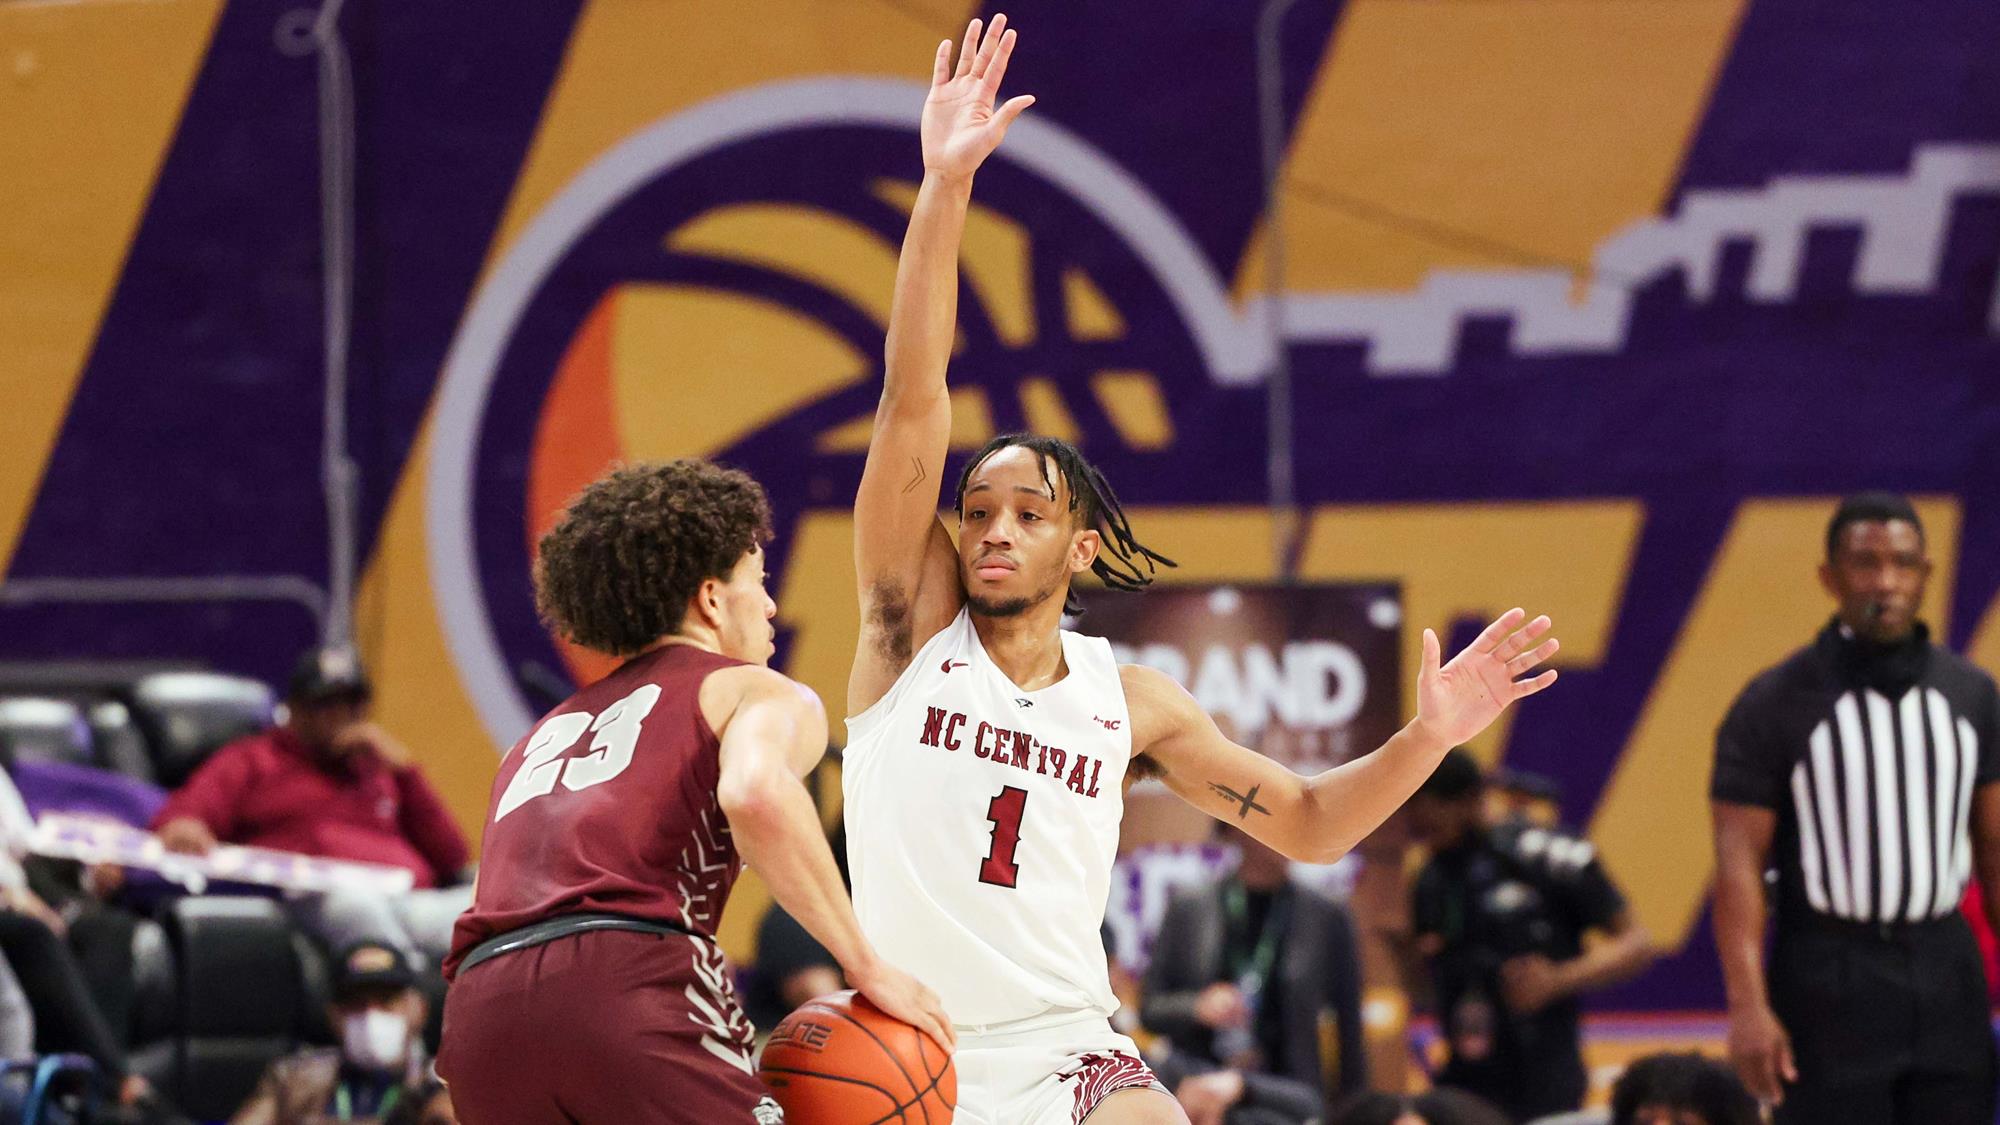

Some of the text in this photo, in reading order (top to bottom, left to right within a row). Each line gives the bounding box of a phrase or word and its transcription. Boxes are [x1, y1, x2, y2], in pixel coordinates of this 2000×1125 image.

[494, 683, 662, 823] 23
[920, 706, 1102, 798] NC CENTRAL
[978, 785, 1028, 889] 1
